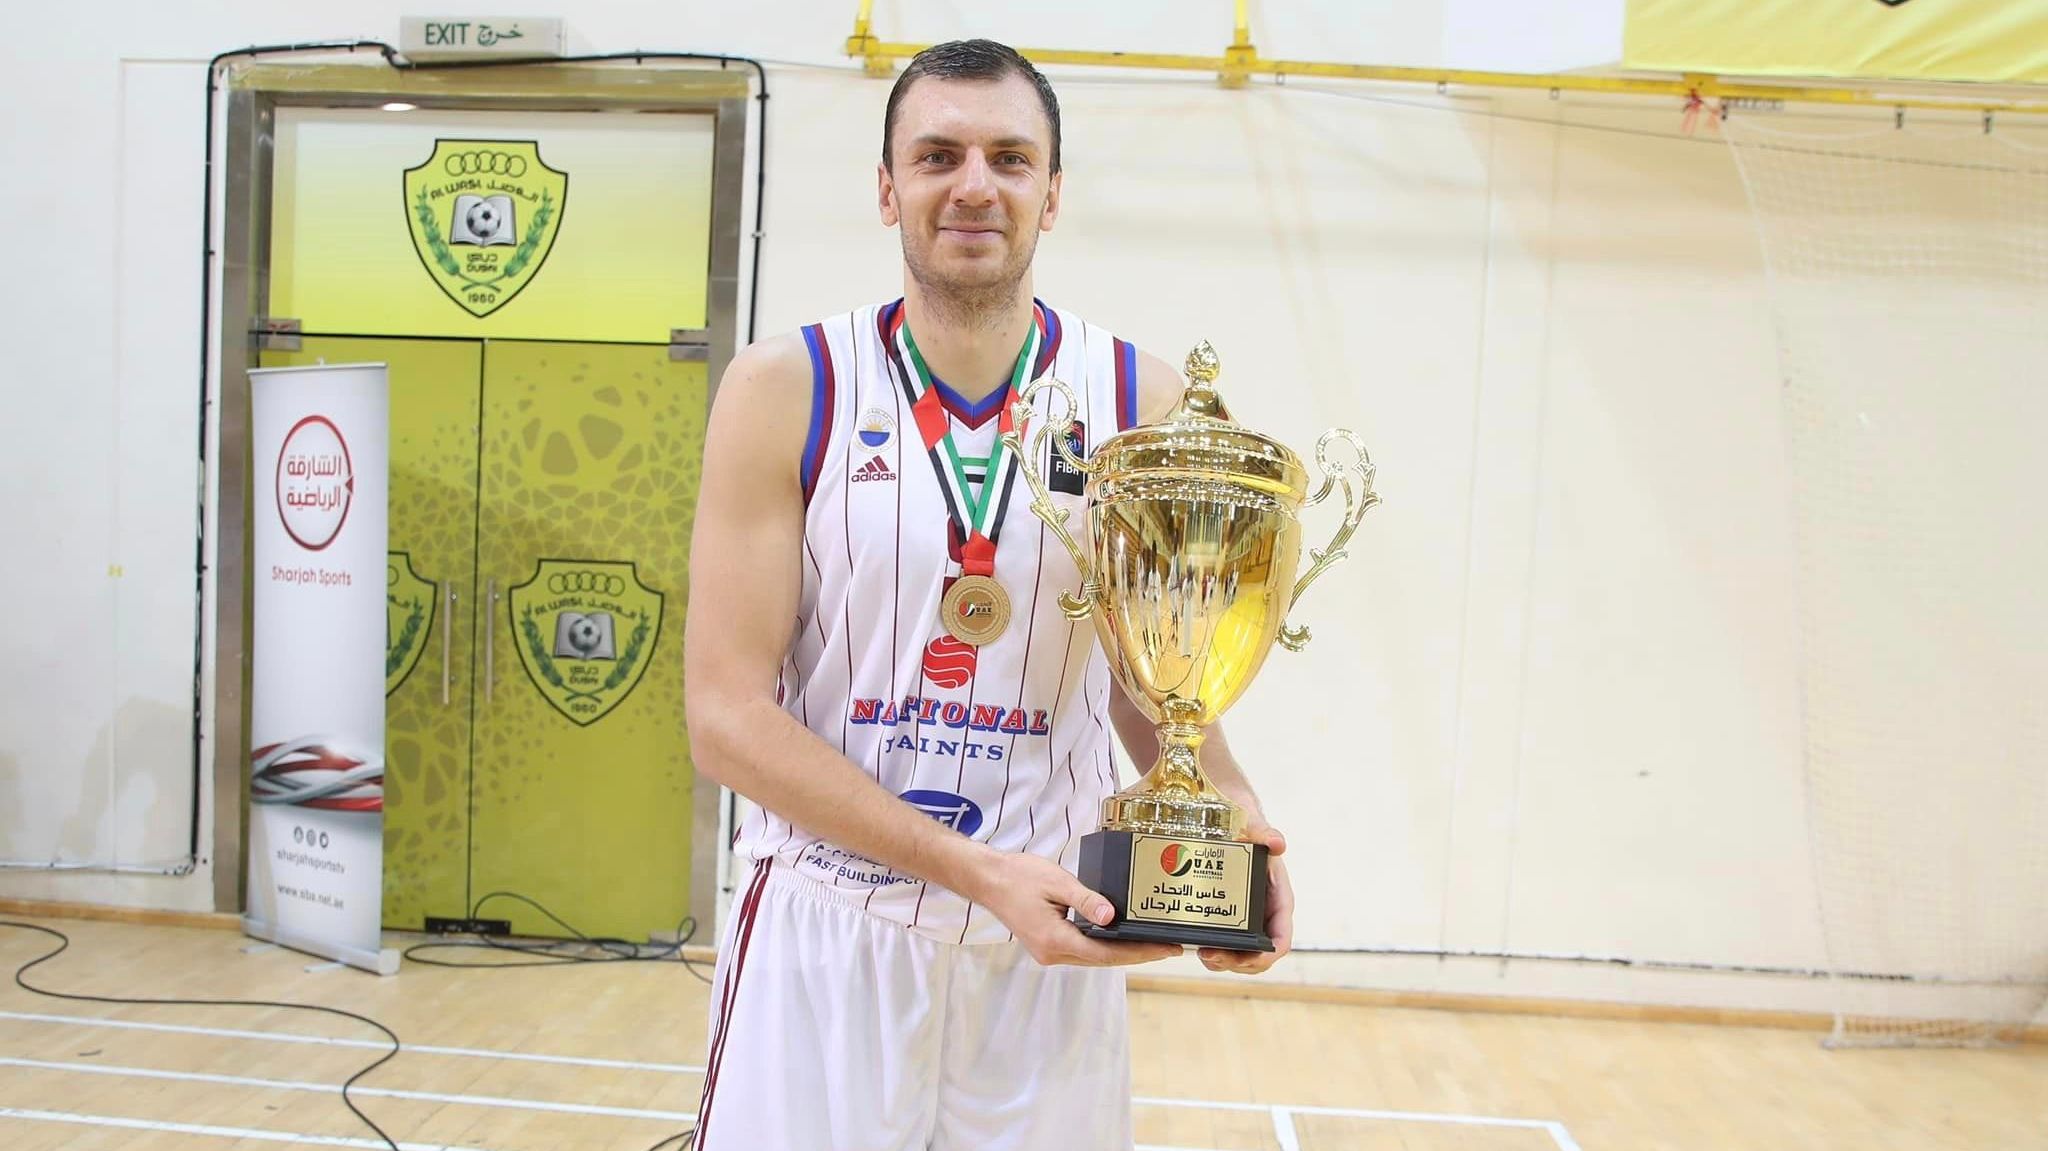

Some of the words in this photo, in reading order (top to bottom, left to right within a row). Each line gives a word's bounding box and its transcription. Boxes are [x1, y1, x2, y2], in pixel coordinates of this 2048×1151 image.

[425, 23, 471, 45] EXIT
[467, 263, 498, 273] DUBAI
[468, 294, 495, 304] 1960
[287, 455, 342, 481] الشارقة
[851, 470, 897, 483] adidas
[287, 485, 341, 511] الرياضية
[272, 566, 317, 585] Sharjah
[319, 568, 352, 587] Sports
[850, 695, 1049, 736] NATIONAL
[1194, 859, 1224, 871] UAE
[1153, 882, 1193, 896] الاتحاد
[1140, 896, 1180, 914] للرجال
[1184, 902, 1237, 917] المفتوحة
